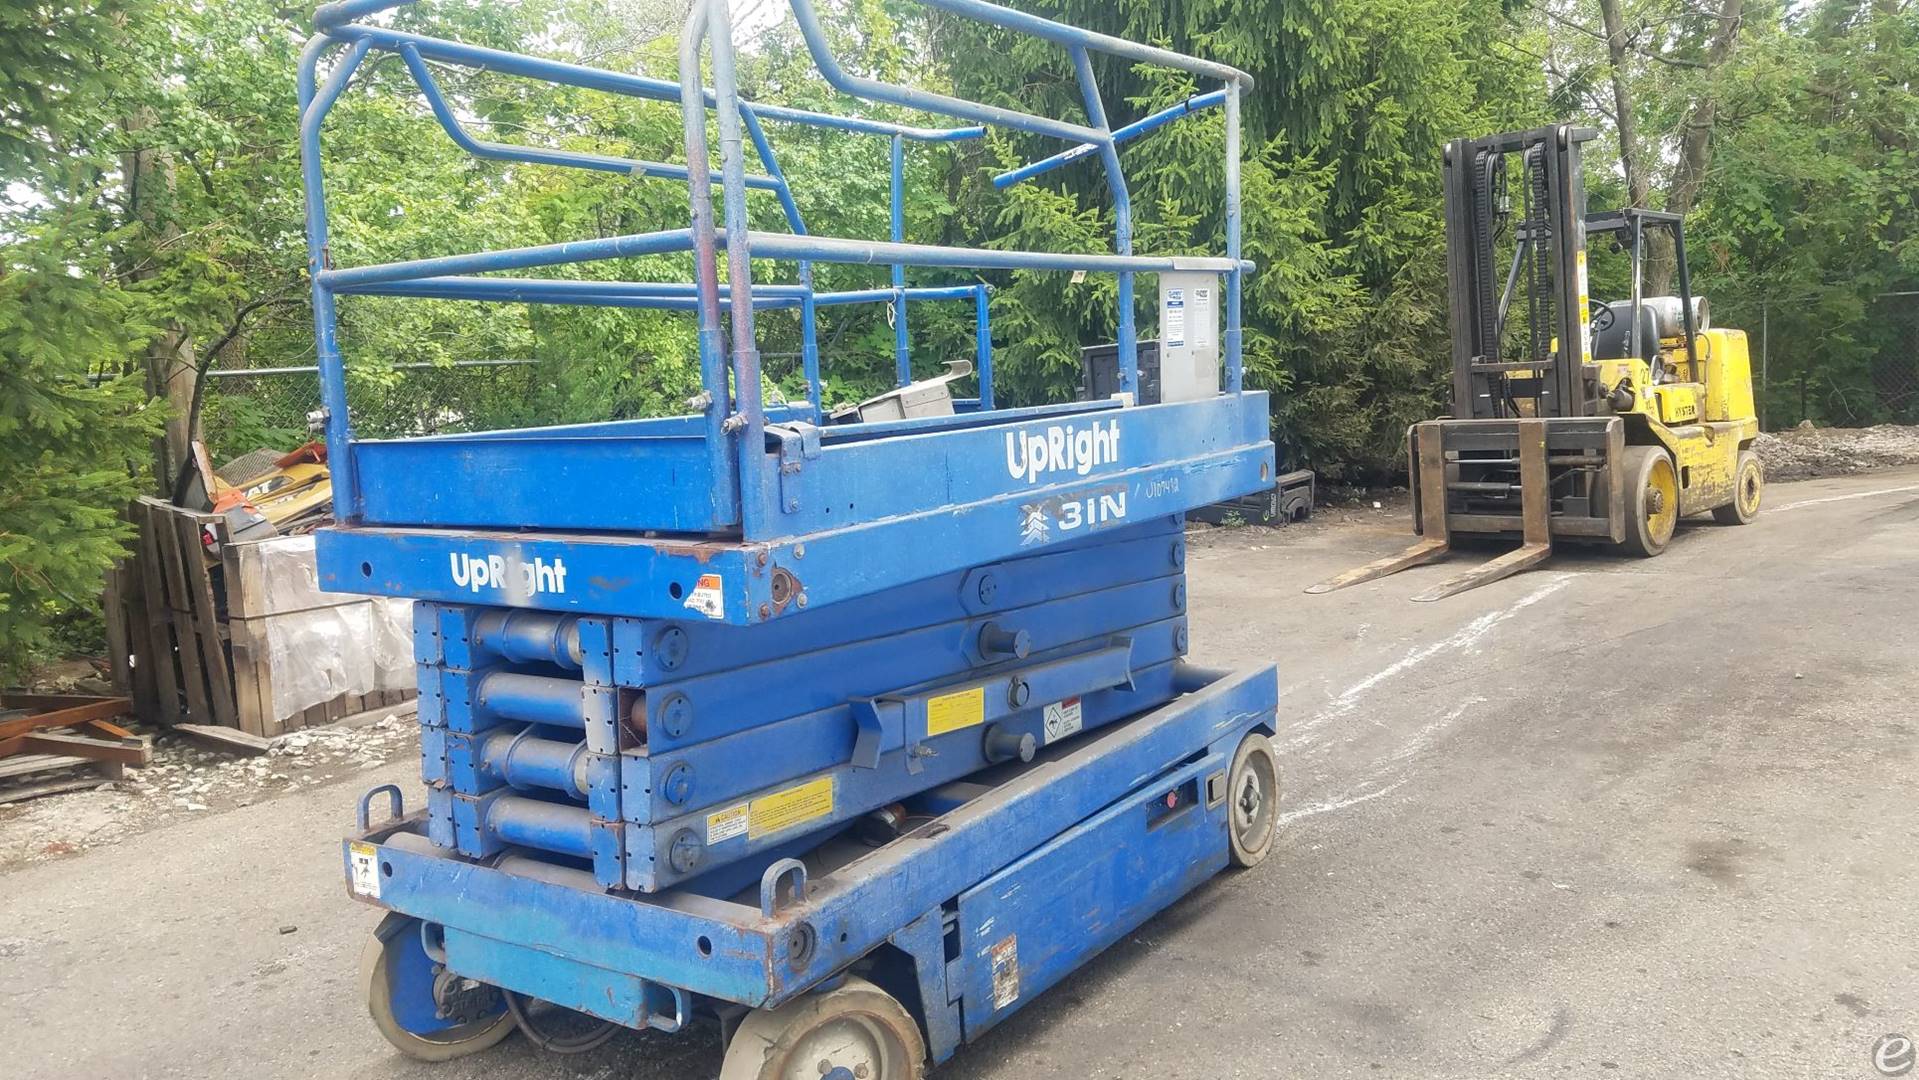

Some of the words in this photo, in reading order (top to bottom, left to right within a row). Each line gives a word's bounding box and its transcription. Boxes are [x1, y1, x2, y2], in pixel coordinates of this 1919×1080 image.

[1675, 404, 1696, 417] HYSTER
[1006, 419, 1120, 483] UpRight
[243, 480, 272, 500] AT
[450, 552, 567, 597] UpRght
